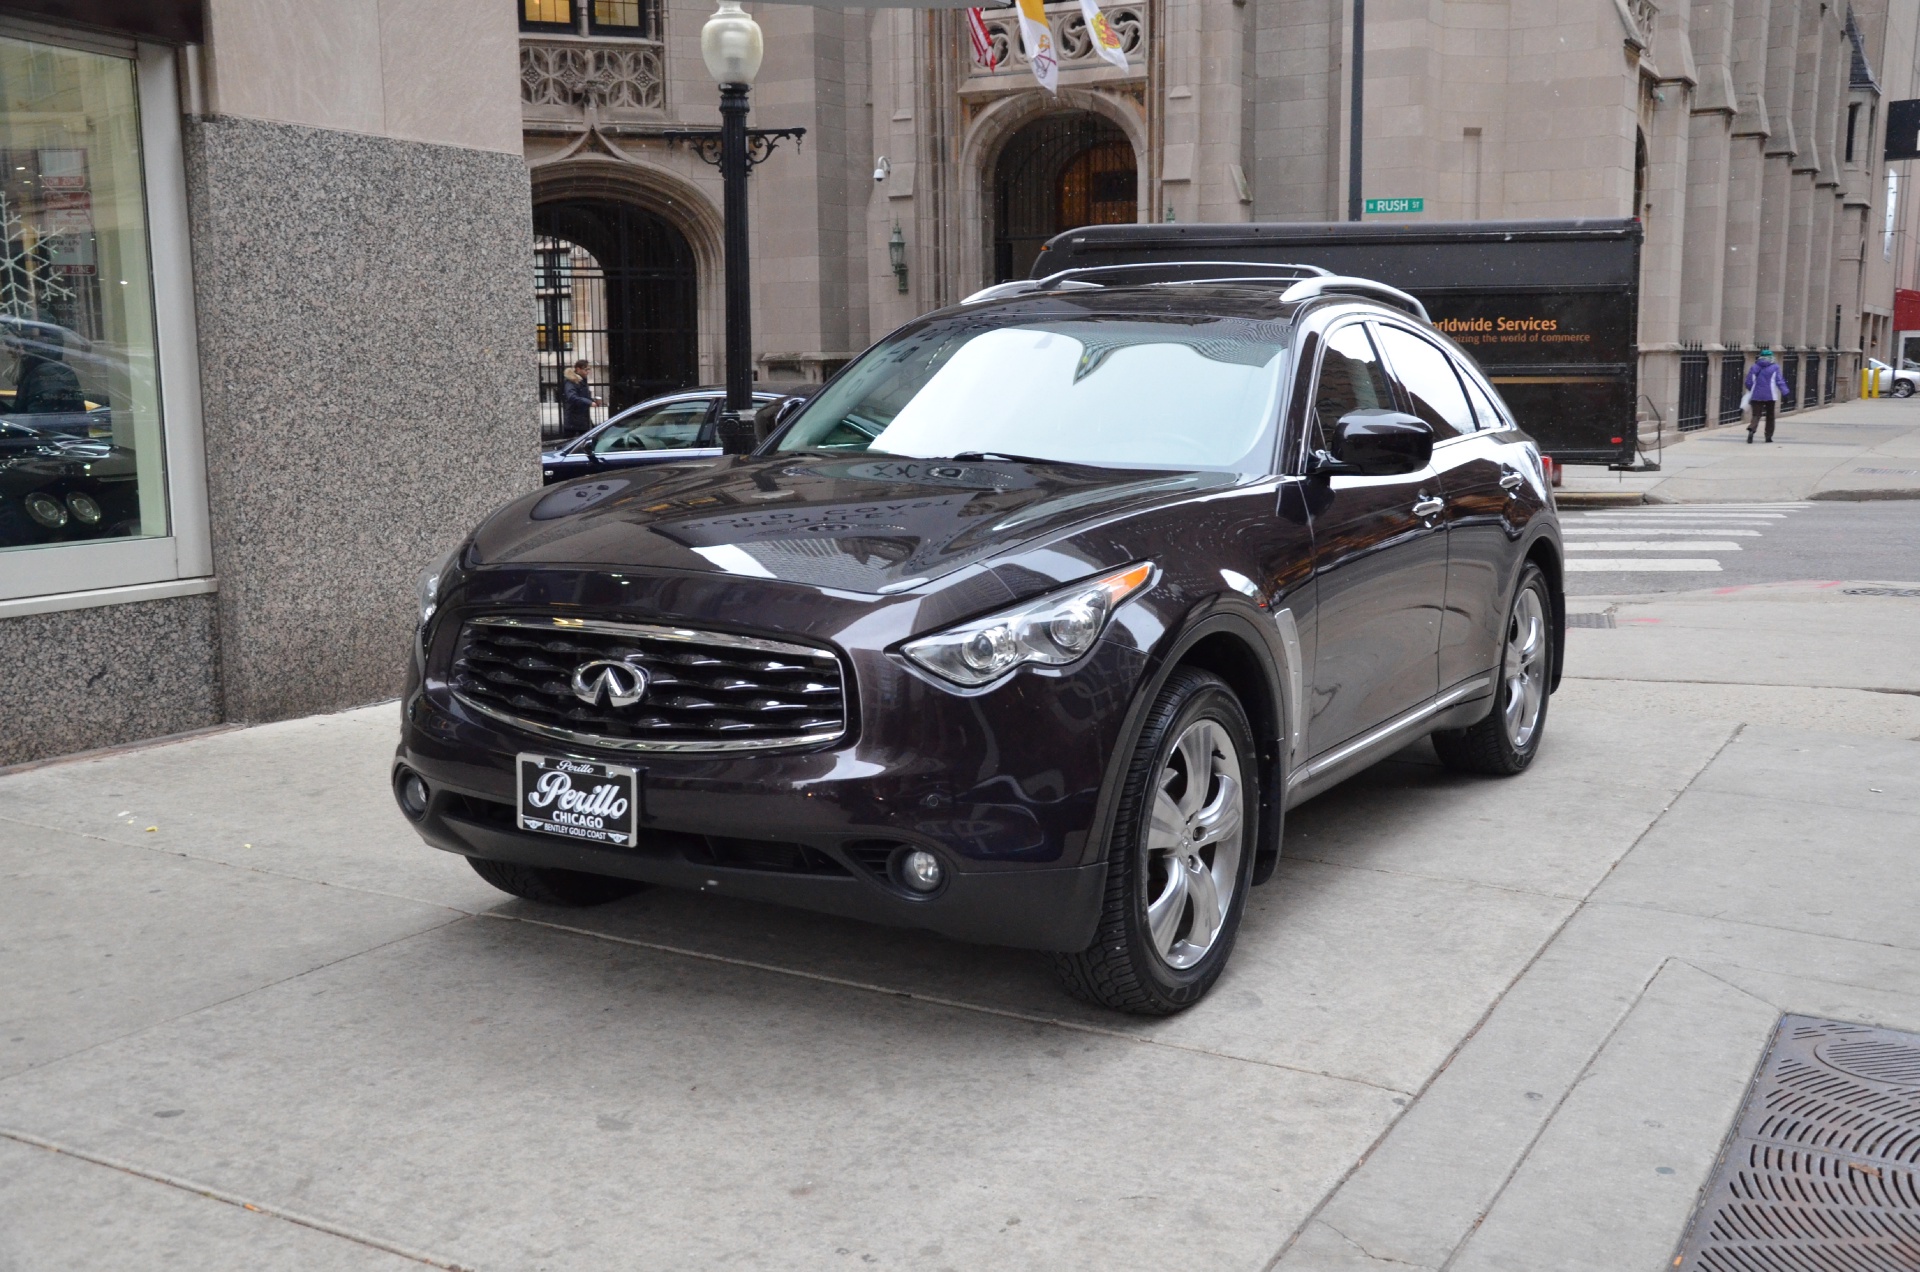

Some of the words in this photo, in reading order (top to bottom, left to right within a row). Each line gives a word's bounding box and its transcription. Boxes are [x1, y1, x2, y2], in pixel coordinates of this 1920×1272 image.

[1377, 199, 1409, 211] RUSH
[1412, 201, 1420, 209] ST
[1497, 316, 1557, 330] Services
[1482, 333, 1498, 343] the
[1501, 333, 1527, 342] world
[1529, 333, 1539, 342] of
[1541, 334, 1591, 342] commerce
[556, 760, 594, 774] Perillo
[528, 771, 628, 819] Perillo
[552, 810, 603, 829] CHICAGO
[544, 823, 569, 833] BENTLEY
[569, 827, 586, 836] GOLD
[587, 830, 606, 839] COAST
